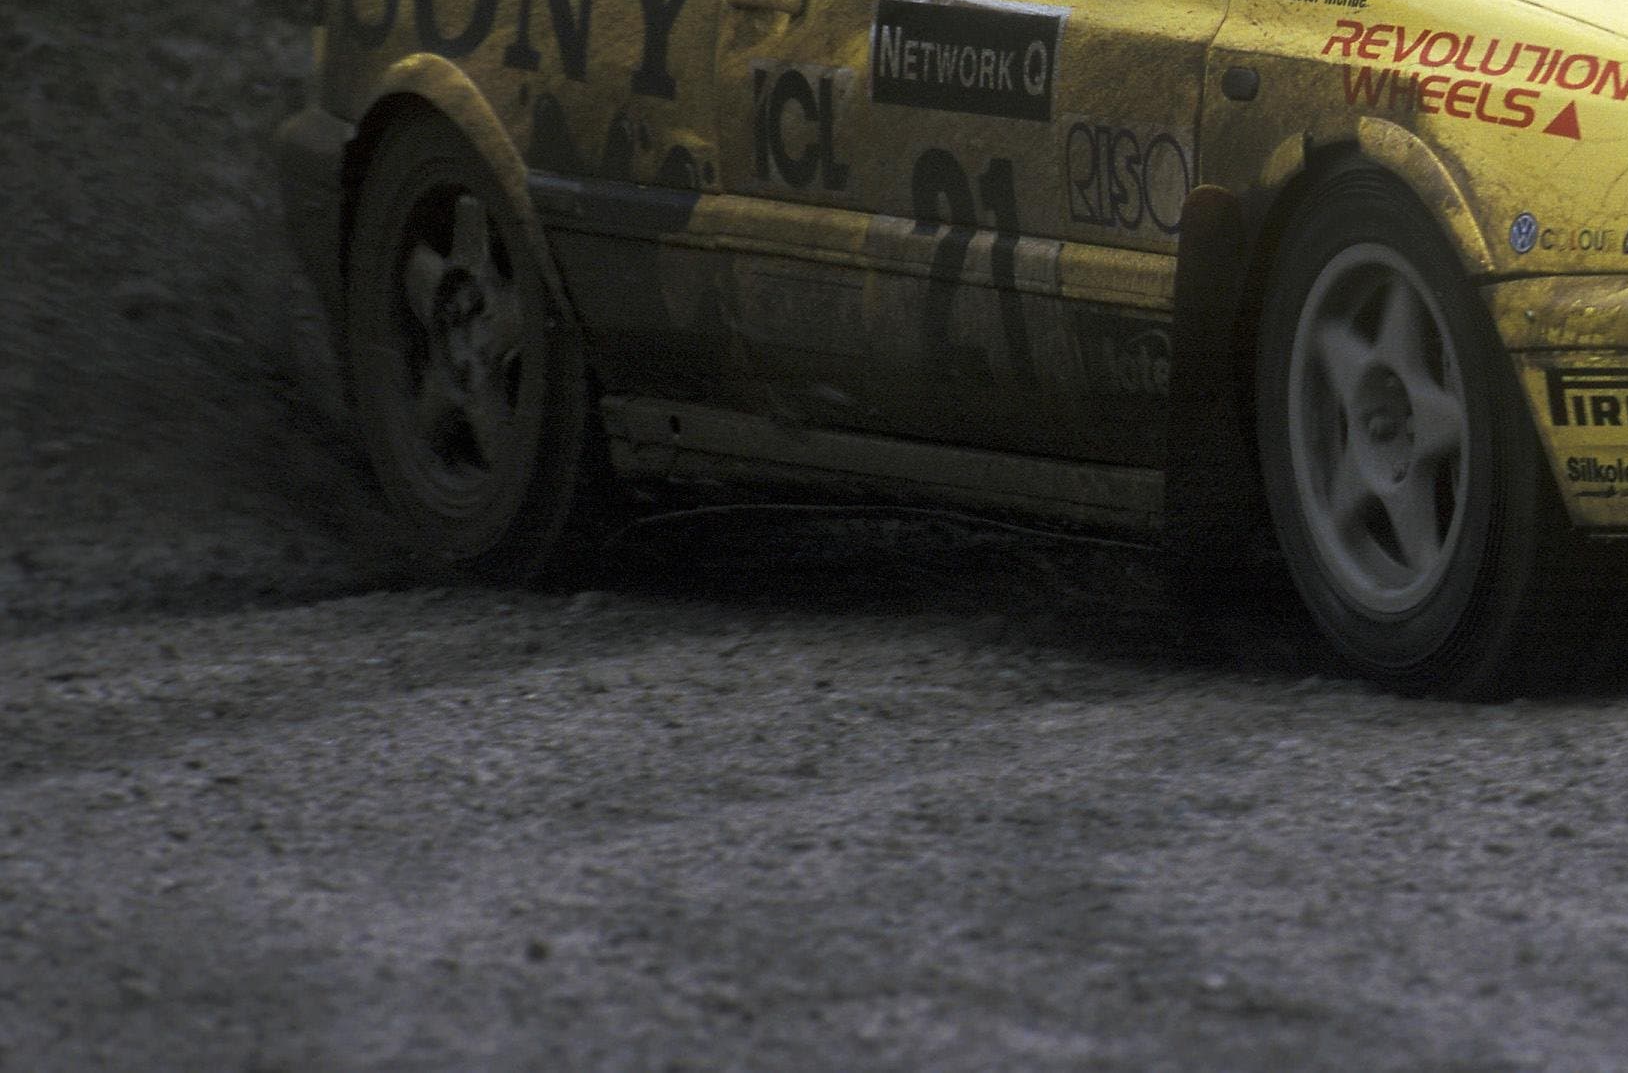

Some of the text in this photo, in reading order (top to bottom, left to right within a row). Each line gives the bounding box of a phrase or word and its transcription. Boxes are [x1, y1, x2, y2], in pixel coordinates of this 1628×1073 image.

[1023, 39, 1048, 96] Q
[1342, 64, 1538, 128] WHEELS
[751, 65, 850, 193] ICL
[1066, 121, 1190, 234] RISO
